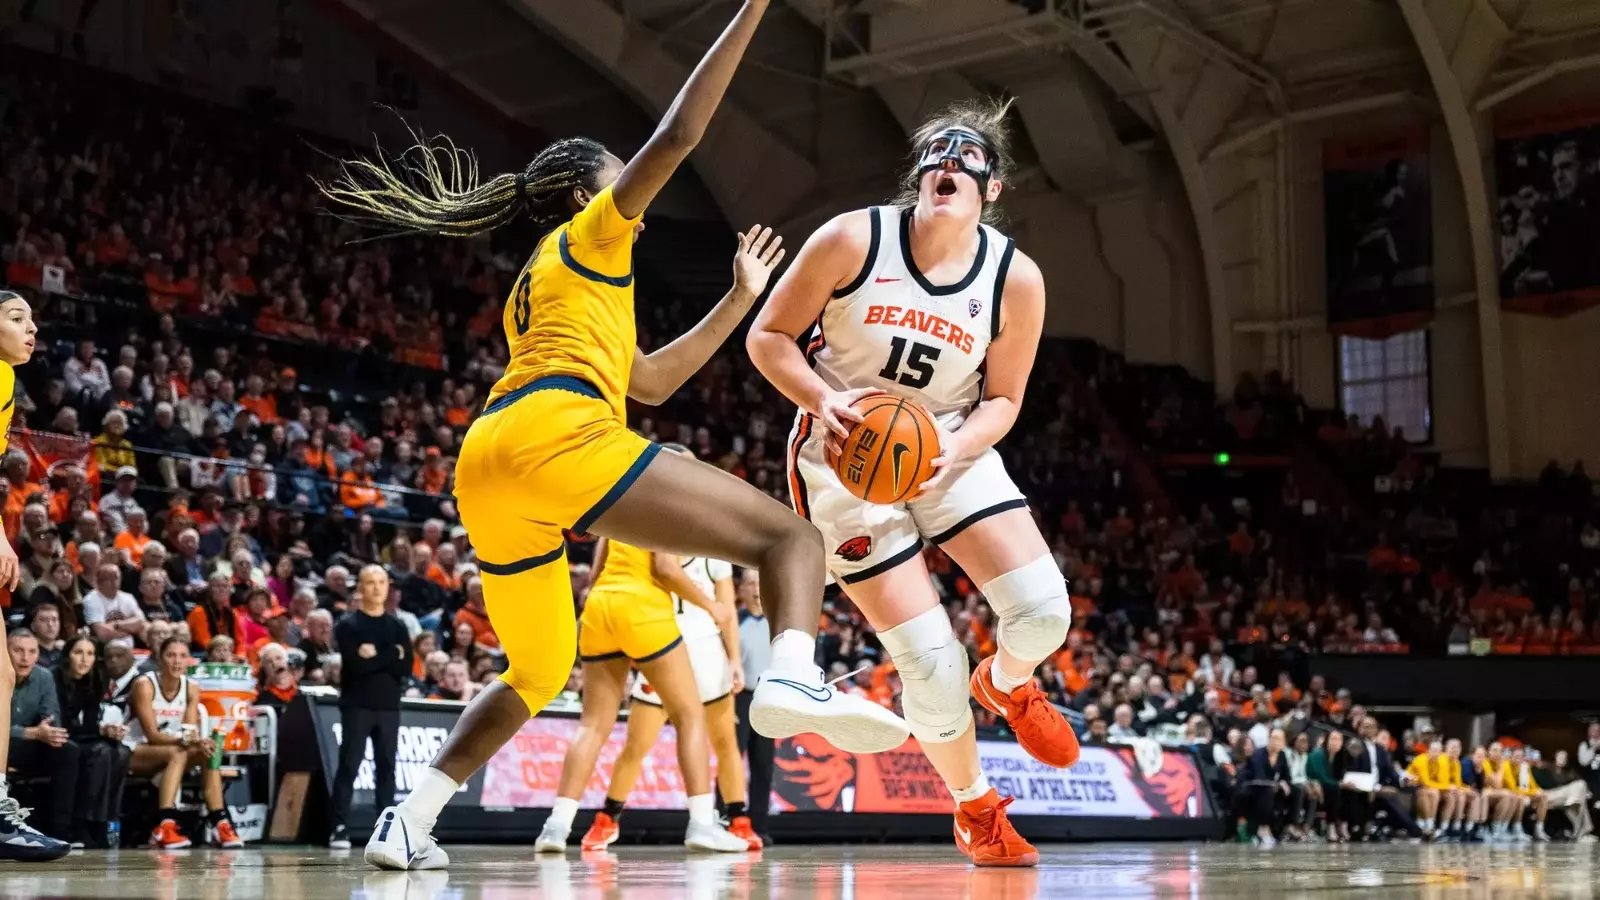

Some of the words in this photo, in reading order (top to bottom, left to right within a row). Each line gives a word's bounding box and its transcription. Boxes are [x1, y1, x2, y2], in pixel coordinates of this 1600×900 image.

[514, 271, 532, 336] 0
[864, 305, 975, 355] BEAVERS
[878, 336, 942, 389] 15
[847, 428, 880, 485] ELITE
[1029, 777, 1117, 802] ATHLETICS
